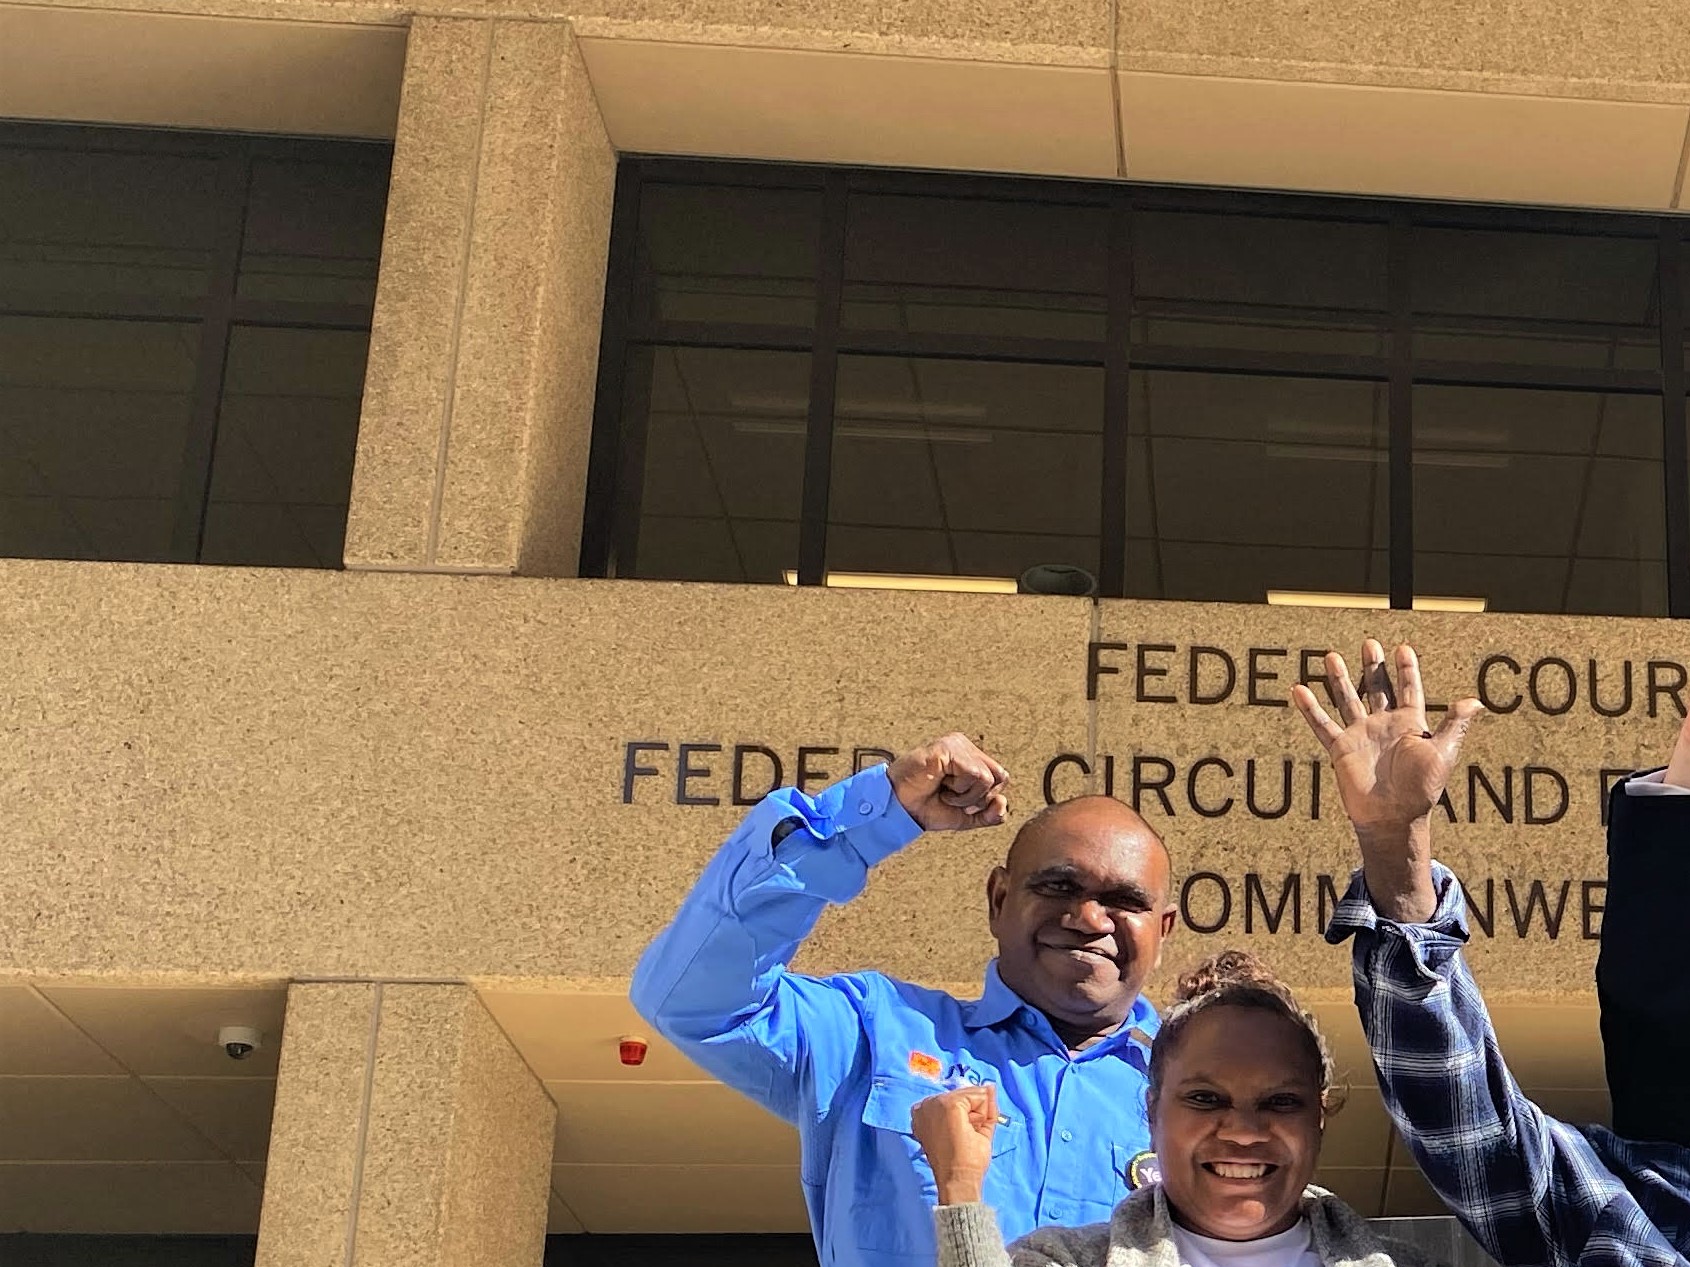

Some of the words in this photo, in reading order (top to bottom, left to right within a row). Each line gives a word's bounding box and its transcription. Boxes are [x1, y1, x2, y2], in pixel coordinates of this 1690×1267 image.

[1086, 640, 1449, 713] FEDER
[622, 740, 897, 806] FEDE
[1042, 753, 1334, 820] CIRCUI
[1436, 763, 1569, 825] ND
[1139, 1167, 1163, 1183] Ye
